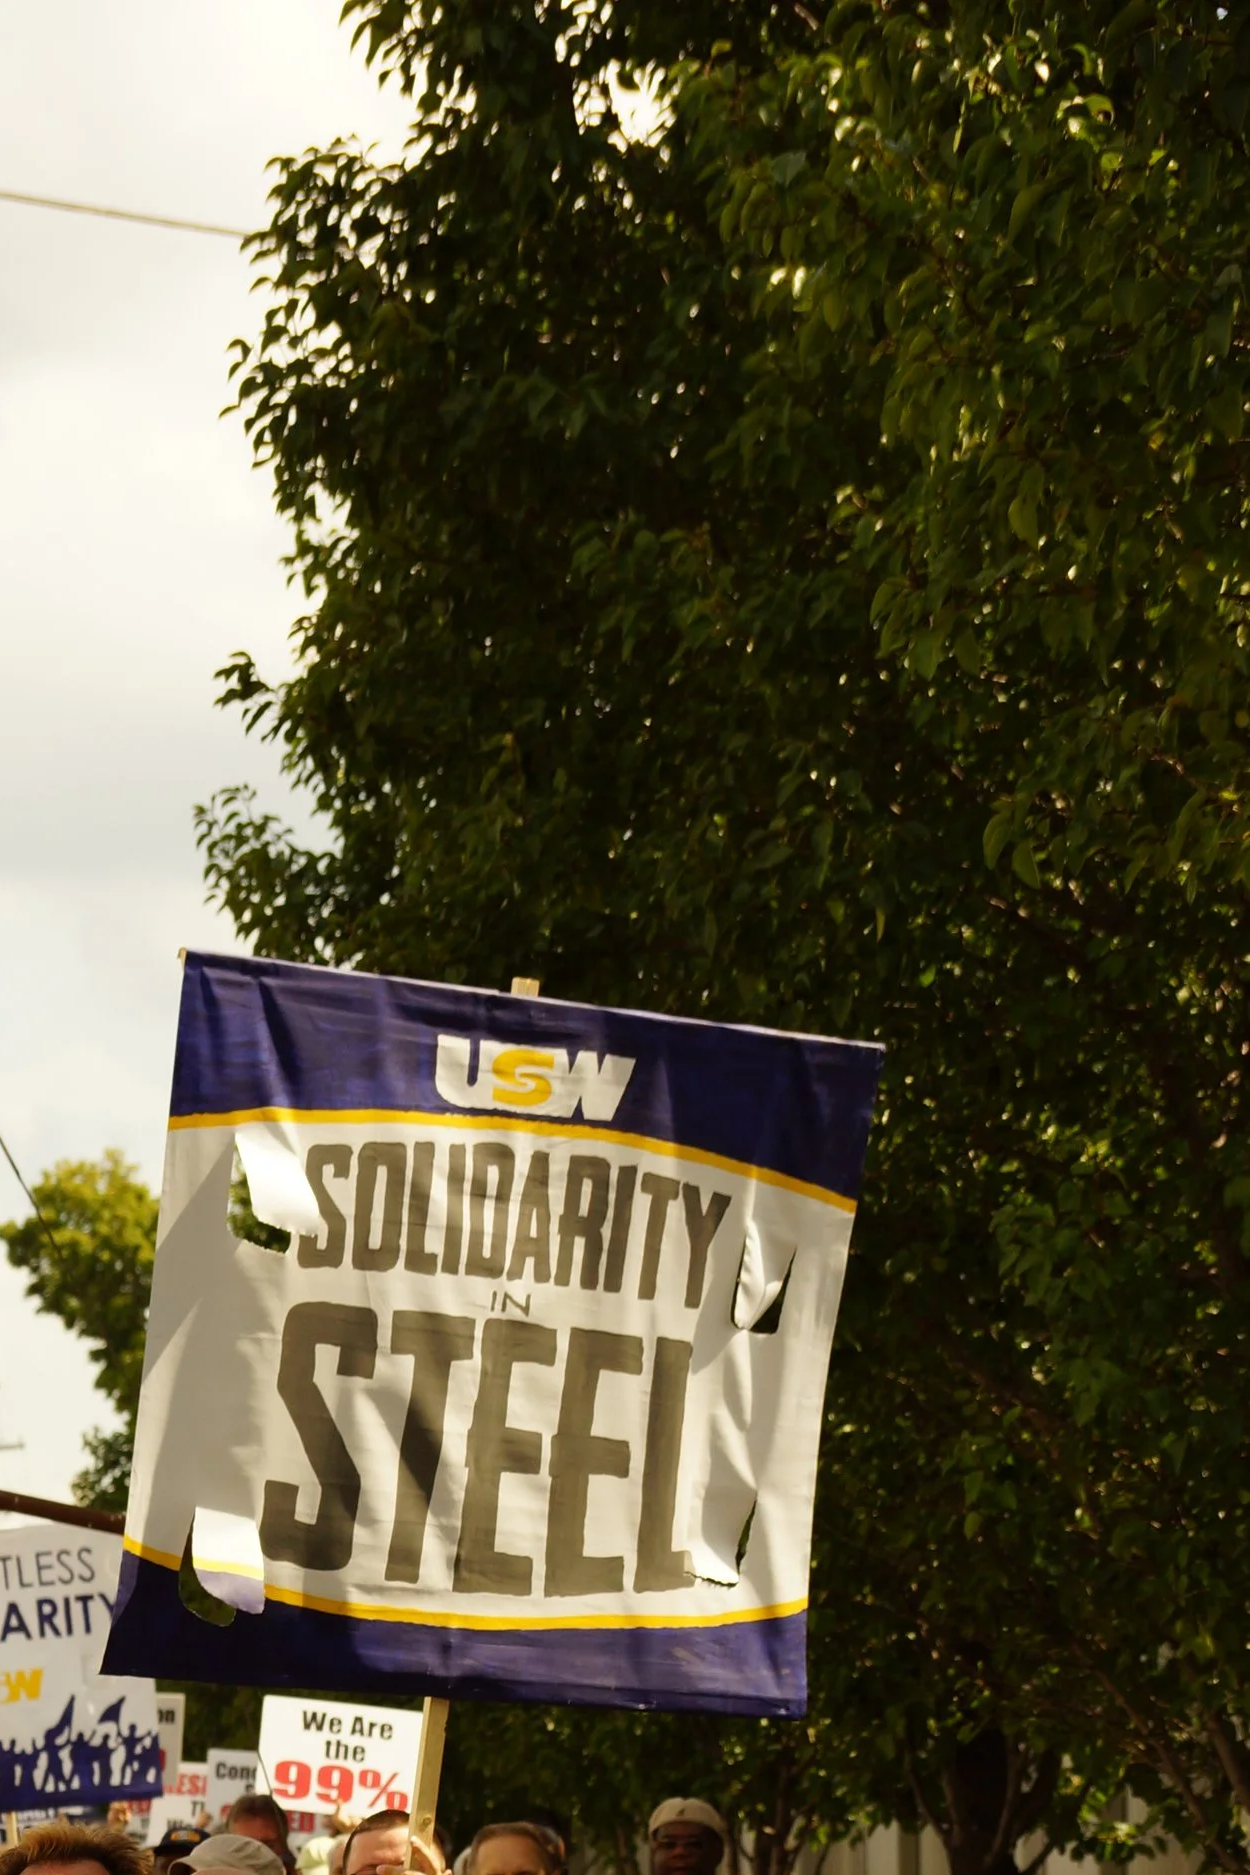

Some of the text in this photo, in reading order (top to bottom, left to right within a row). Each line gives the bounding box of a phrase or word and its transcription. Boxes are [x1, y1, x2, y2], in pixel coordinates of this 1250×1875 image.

[435, 1034, 637, 1122] USW
[296, 1141, 732, 1309] SOLIDARITY
[490, 1290, 531, 1317] IN
[259, 1301, 696, 1598] STEEL
[302, 1710, 393, 1741] We Are
[325, 1740, 366, 1763] the
[273, 1760, 409, 1812] 99%
